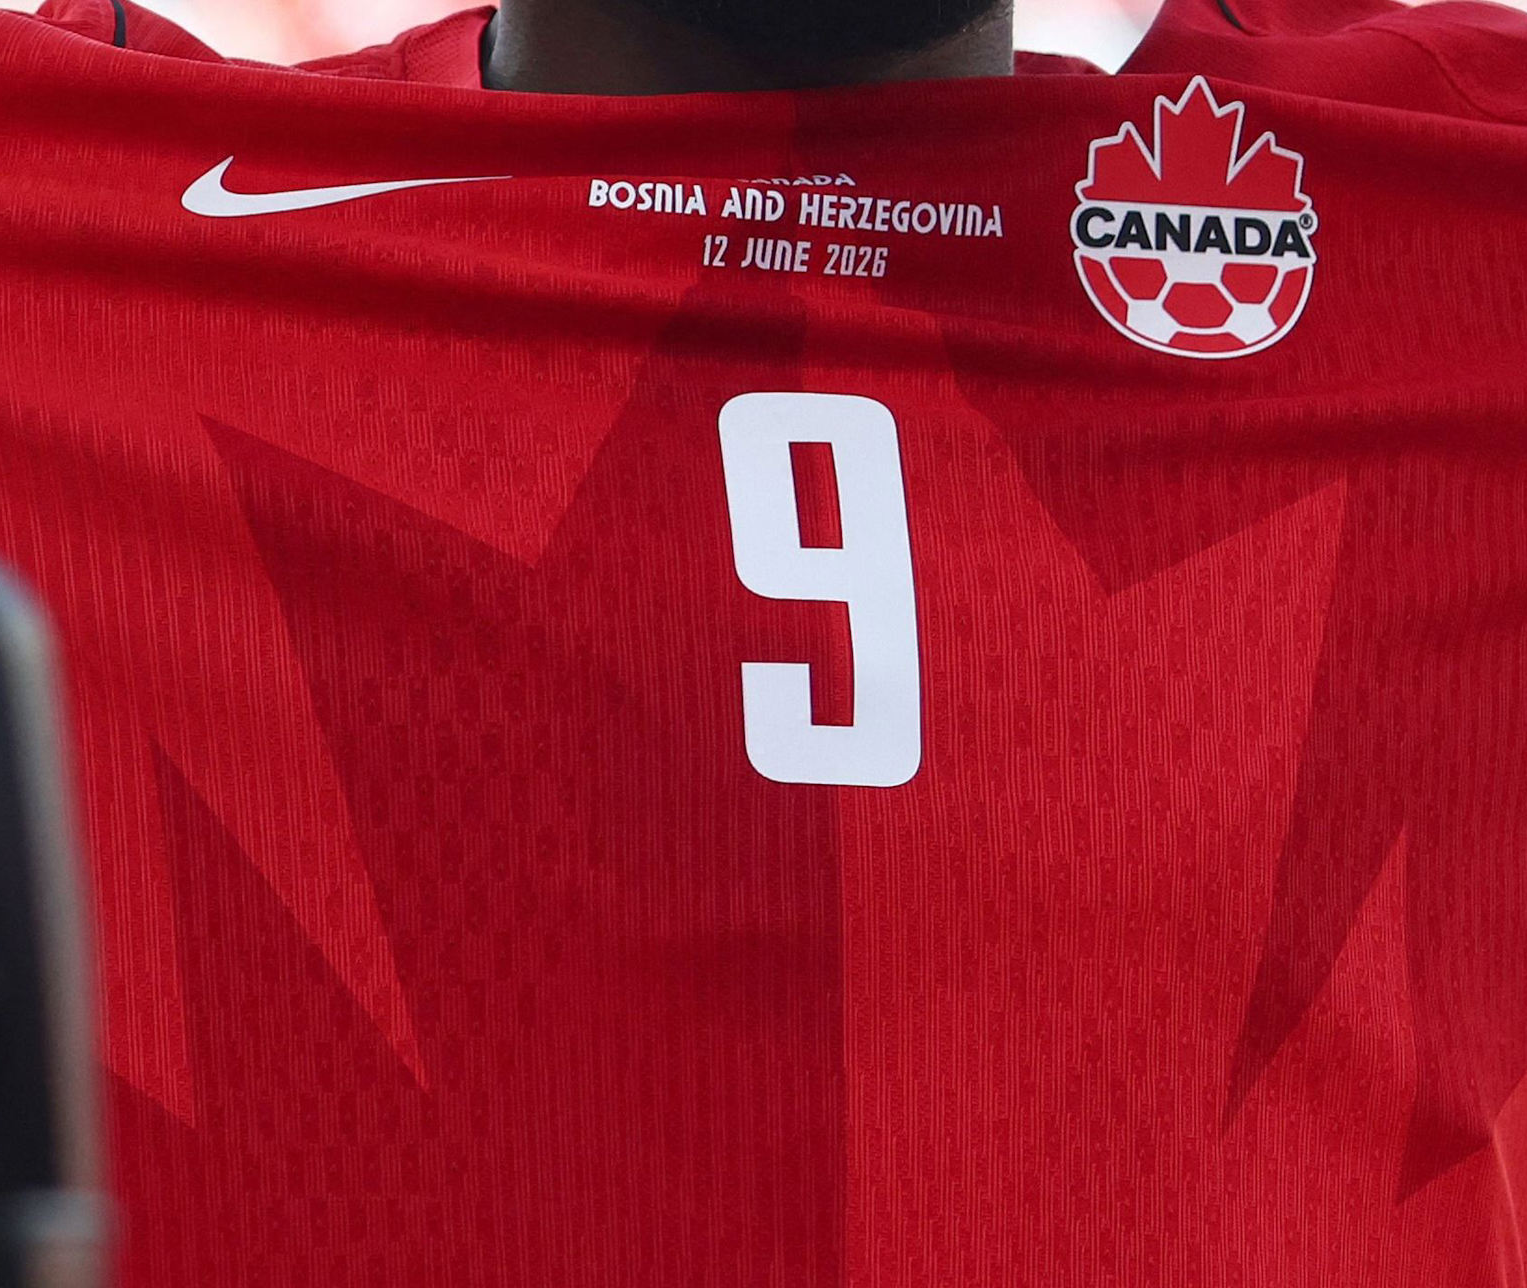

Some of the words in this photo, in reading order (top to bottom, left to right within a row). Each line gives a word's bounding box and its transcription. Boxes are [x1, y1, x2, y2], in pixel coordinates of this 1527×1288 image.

[588, 179, 707, 216] BOSNIA
[720, 186, 785, 222] AND
[798, 192, 1004, 238] HERZEGOVINA
[703, 234, 728, 267] 12
[740, 237, 811, 273] JUNE
[823, 244, 889, 278] 2026
[718, 392, 922, 788] 9
